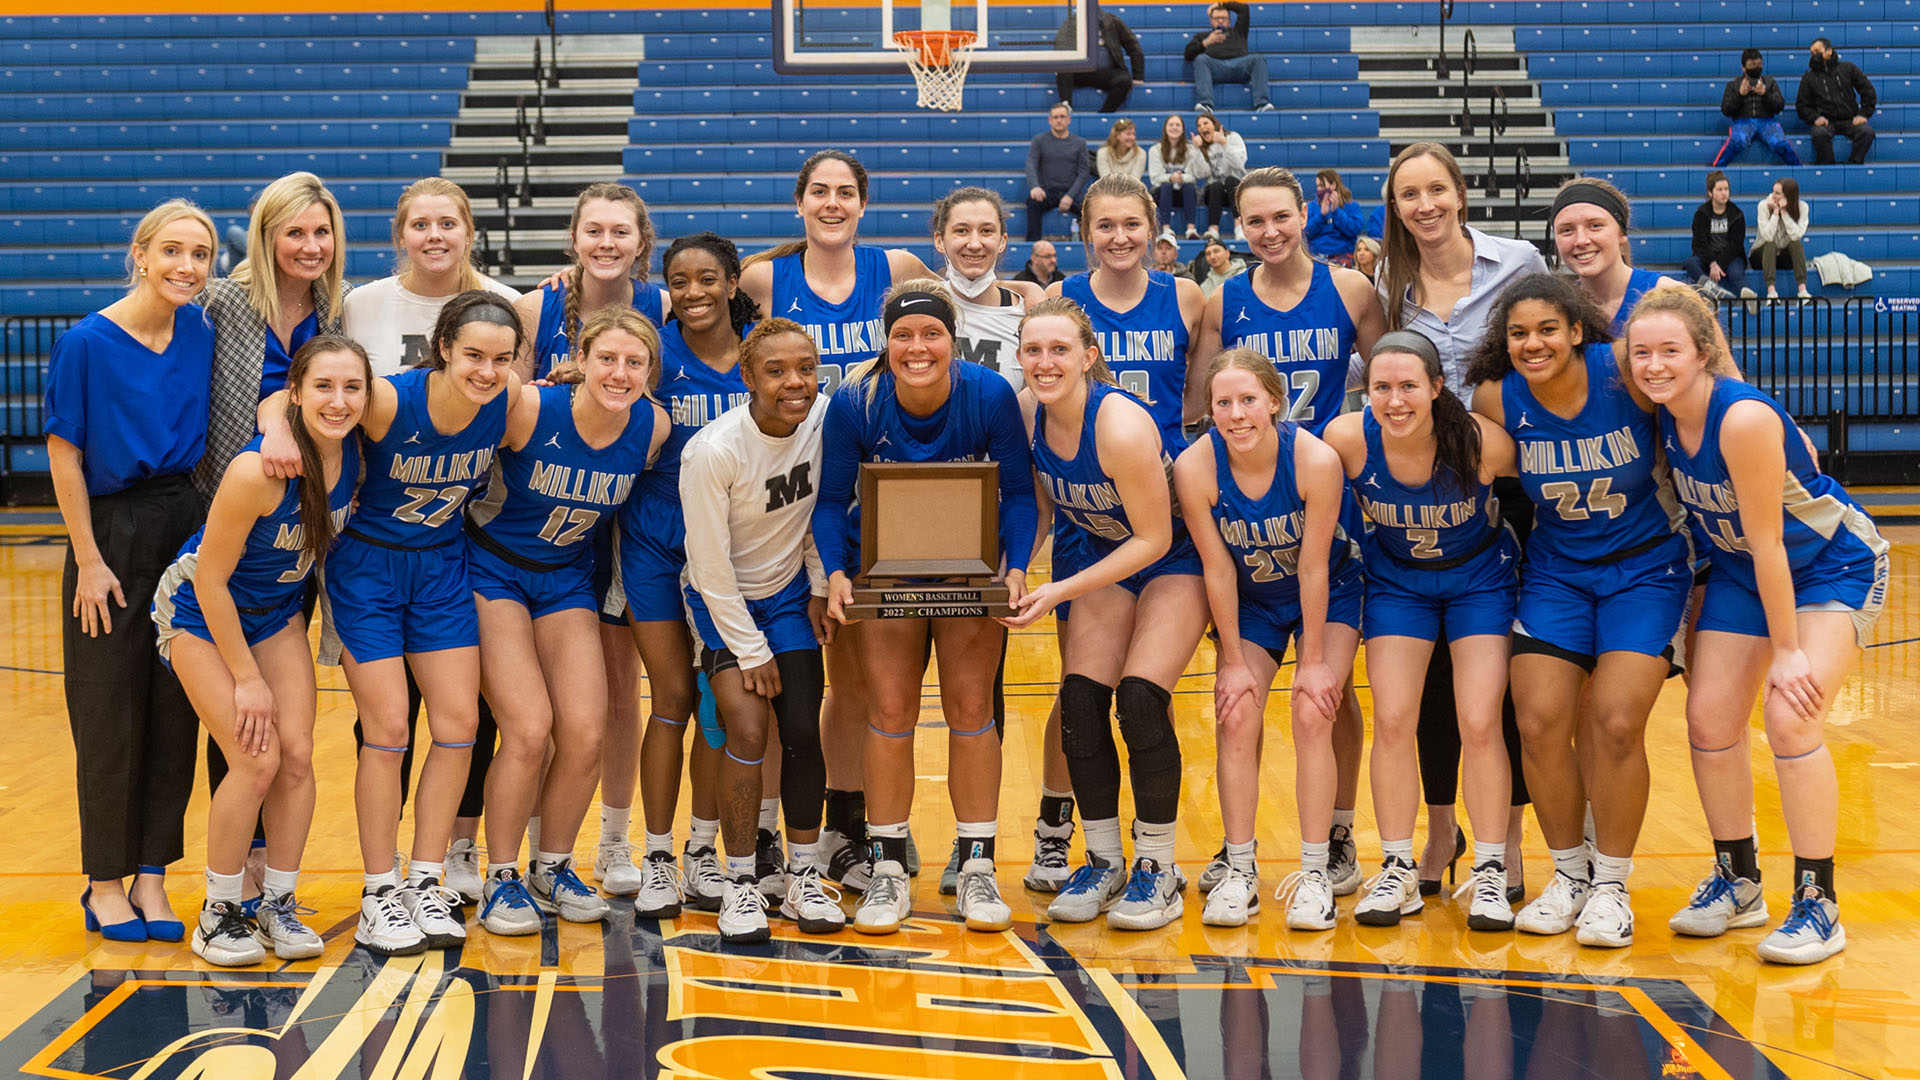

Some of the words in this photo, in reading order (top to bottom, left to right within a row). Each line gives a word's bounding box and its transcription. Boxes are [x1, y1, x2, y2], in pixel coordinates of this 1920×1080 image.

[389, 444, 494, 483] MILLIKIN
[1519, 425, 1641, 474] MILLIKIN
[528, 459, 635, 505] MILLIKIN
[765, 460, 813, 513] M
[1541, 477, 1627, 520] 24
[392, 485, 469, 528] 22
[537, 505, 601, 546] 12
[1362, 495, 1476, 529] MILLIKIN
[1406, 528, 1443, 559] 2
[883, 609, 904, 617] 2022
[917, 607, 983, 616] CHAMPIONS
[925, 592, 979, 601] BASKETBALL
